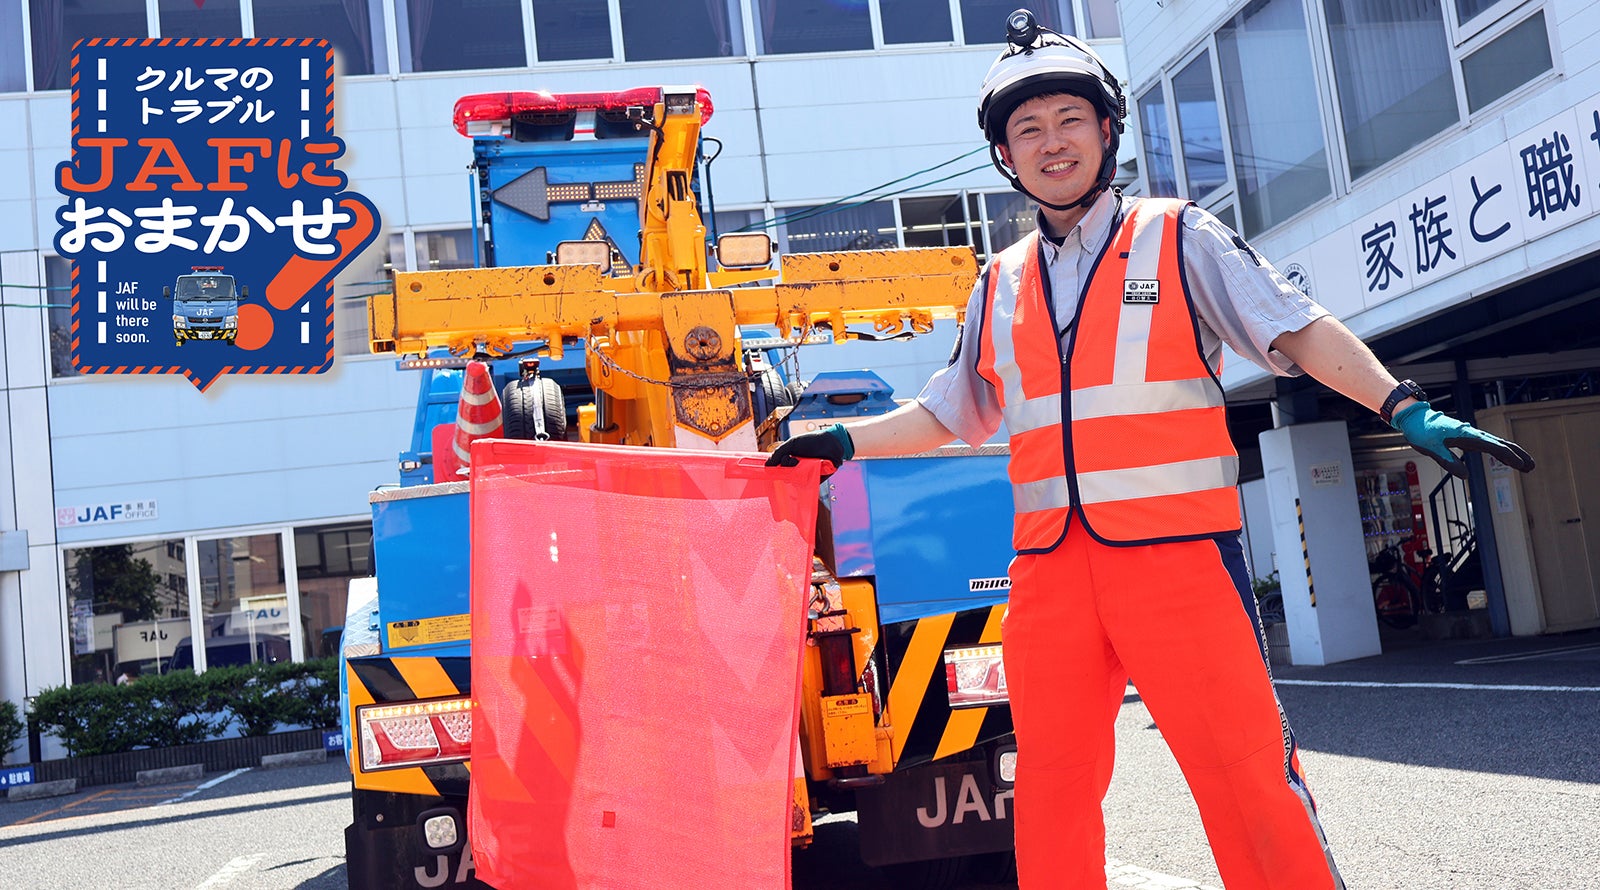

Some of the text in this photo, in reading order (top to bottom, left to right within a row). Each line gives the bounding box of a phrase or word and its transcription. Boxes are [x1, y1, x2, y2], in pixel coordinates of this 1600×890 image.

[1361, 108, 1600, 292] 家族と職
[77, 504, 122, 522] JAF
[125, 501, 156, 511] 事務局
[125, 510, 155, 519] OFFICE
[1276, 703, 1292, 785] FEDERAION
